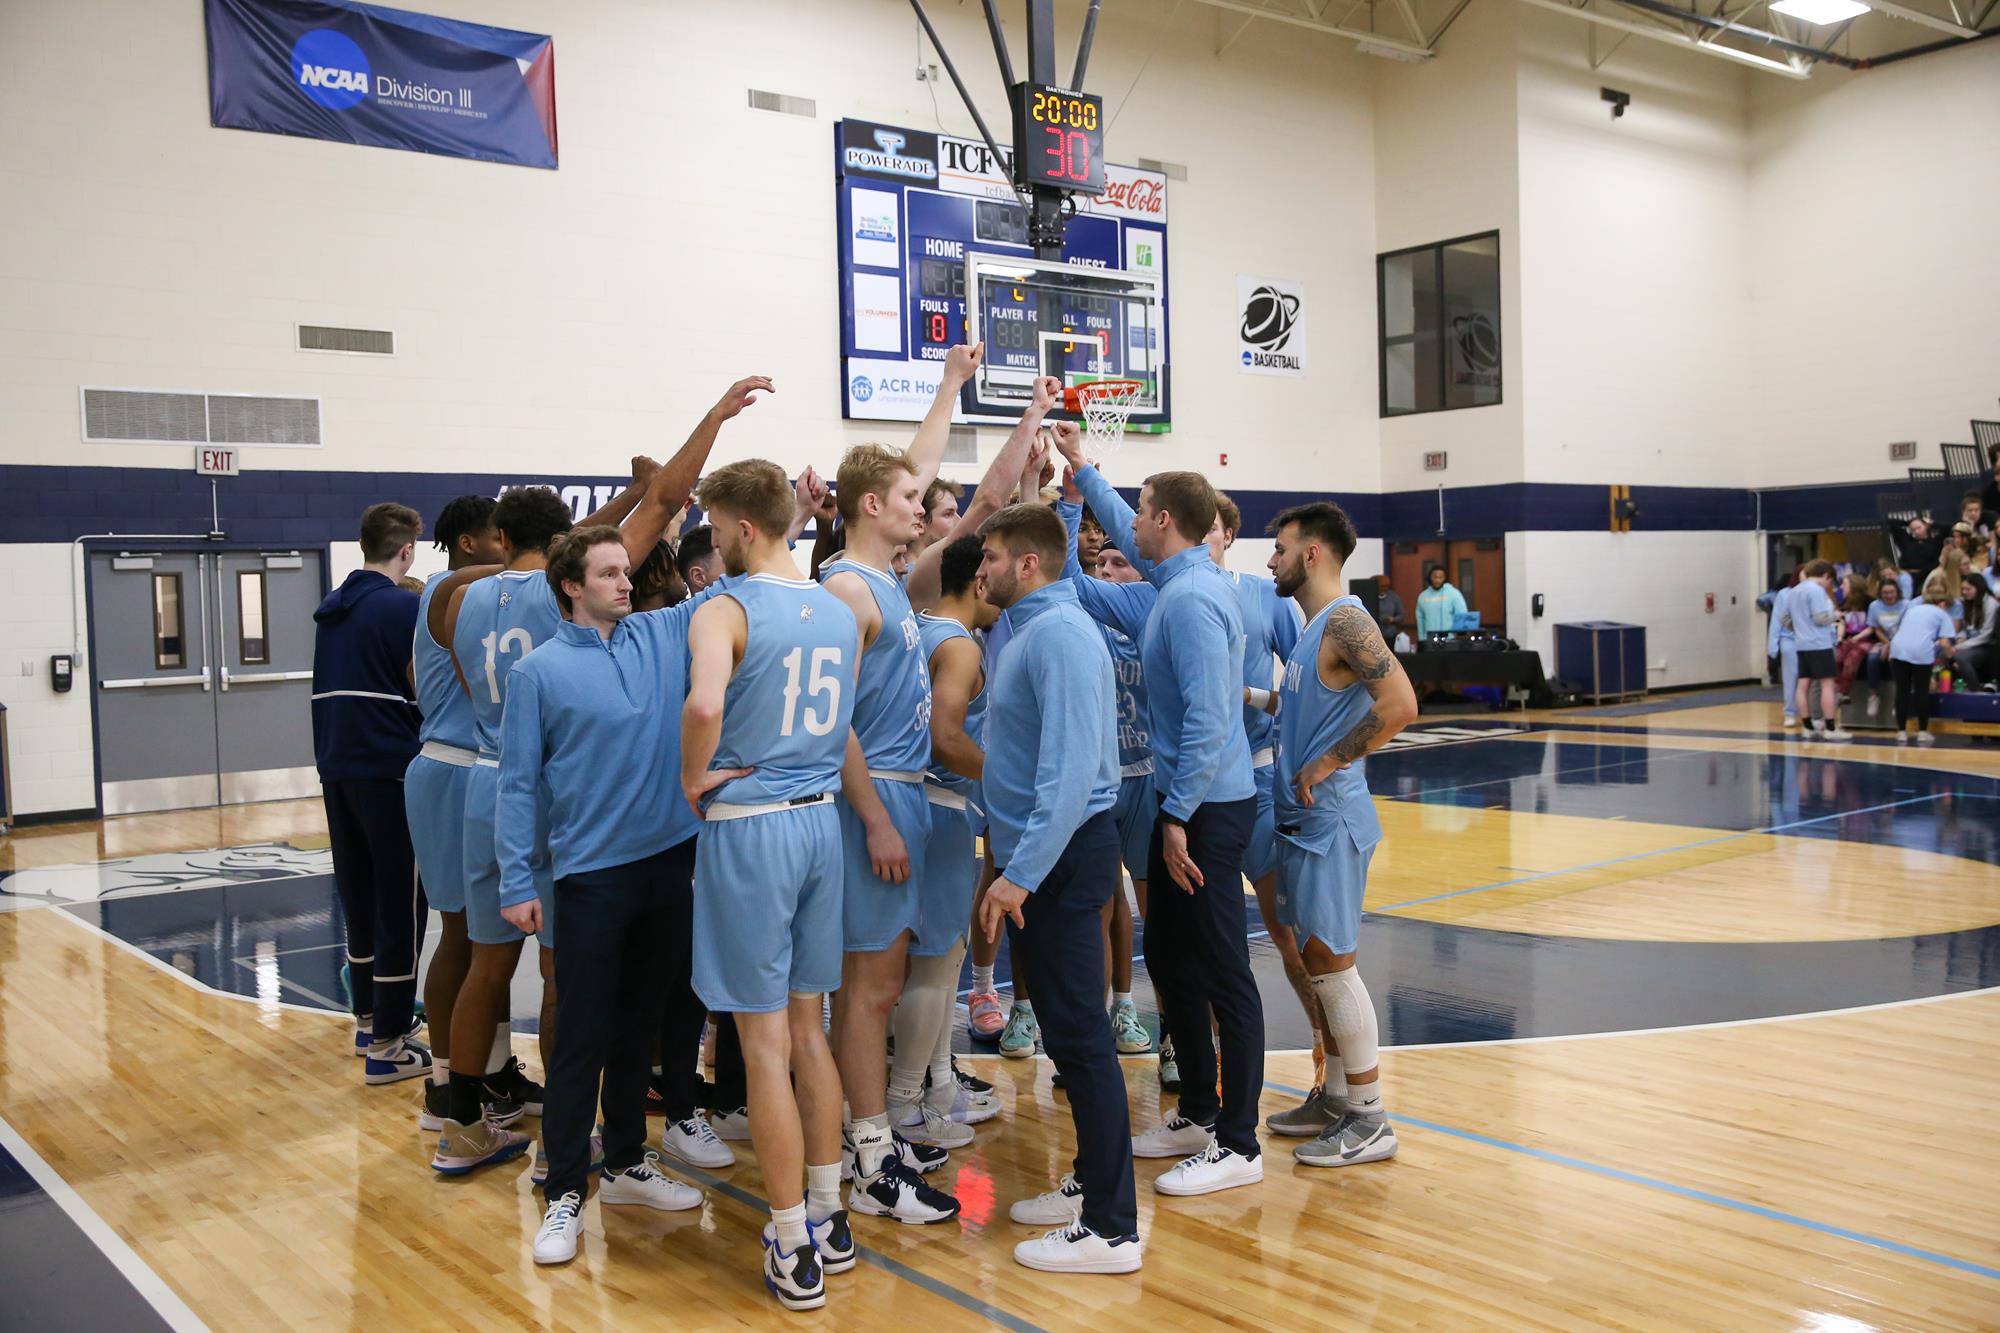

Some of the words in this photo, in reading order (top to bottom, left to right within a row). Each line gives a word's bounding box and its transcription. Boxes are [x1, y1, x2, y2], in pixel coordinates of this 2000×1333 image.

[300, 64, 369, 94] NCAA
[376, 76, 453, 106] Division
[459, 88, 472, 109] III
[1045, 85, 1084, 98] DAKTRONICS
[1032, 92, 1097, 131] 20:00
[848, 150, 932, 175] POWERADE
[942, 140, 992, 175] TCF
[1045, 126, 1089, 180] 30
[925, 238, 964, 259] HOME
[920, 299, 949, 313] FOULS
[991, 306, 1024, 321] PLAYER
[931, 314, 946, 342] 0
[1086, 316, 1112, 329] FOULS
[1006, 354, 1036, 367] MATCH
[1087, 360, 1113, 373] SCRE
[1254, 353, 1301, 370] BASKETBALL
[879, 378, 910, 393] ACR
[203, 450, 233, 471] EXIT
[780, 646, 842, 737] 15
